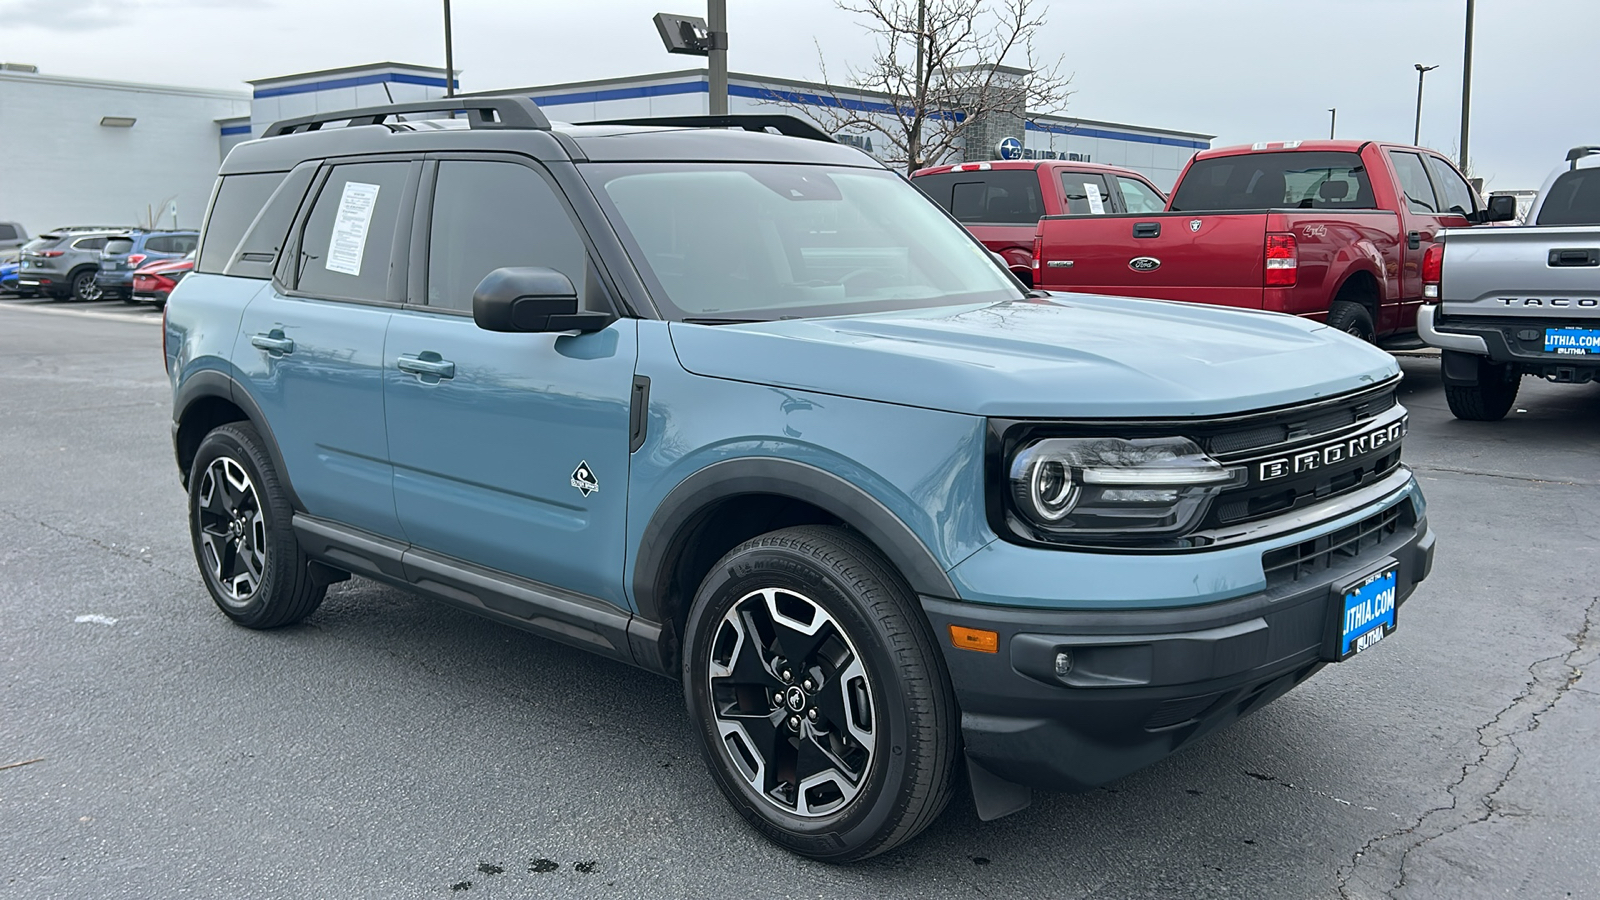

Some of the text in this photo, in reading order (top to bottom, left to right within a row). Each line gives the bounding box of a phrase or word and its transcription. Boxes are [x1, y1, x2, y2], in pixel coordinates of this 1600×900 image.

[1023, 147, 1091, 163] SUBARU
[1133, 258, 1155, 269] Ford
[1496, 297, 1598, 307] TACO
[1544, 334, 1600, 347] LITHIA.COM
[1564, 347, 1586, 355] LITHIA
[1259, 421, 1403, 481] BRONCO
[1343, 586, 1395, 636] ITHIA.COM
[1363, 625, 1385, 650] LITHIA
